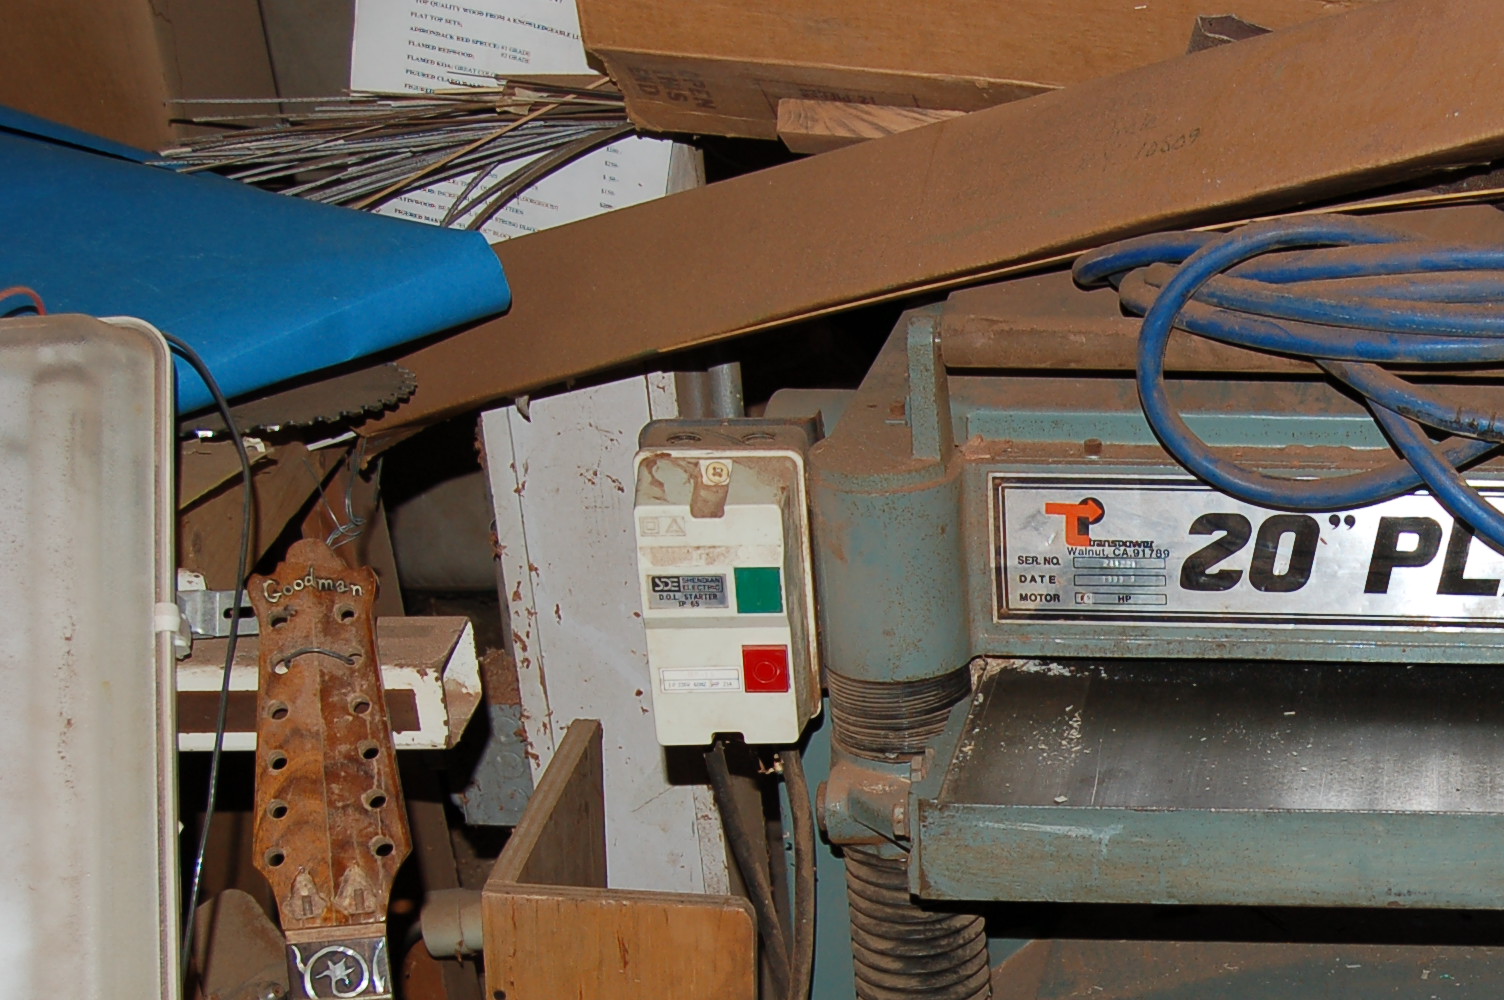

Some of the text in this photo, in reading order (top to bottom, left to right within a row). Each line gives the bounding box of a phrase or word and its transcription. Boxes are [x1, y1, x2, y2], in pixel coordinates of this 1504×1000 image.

[410, 11, 428, 20] FLAT
[430, 14, 444, 22] TOP
[485, 11, 506, 21] FROM
[407, 54, 436, 66] FLAMED
[1067, 546, 1110, 558] Walnut,
[262, 567, 364, 603] Goodman
[1018, 574, 1058, 585] DATE
[684, 592, 718, 602] STARTER
[1018, 592, 1132, 604] MOTOR HP
[678, 600, 687, 608] IP
